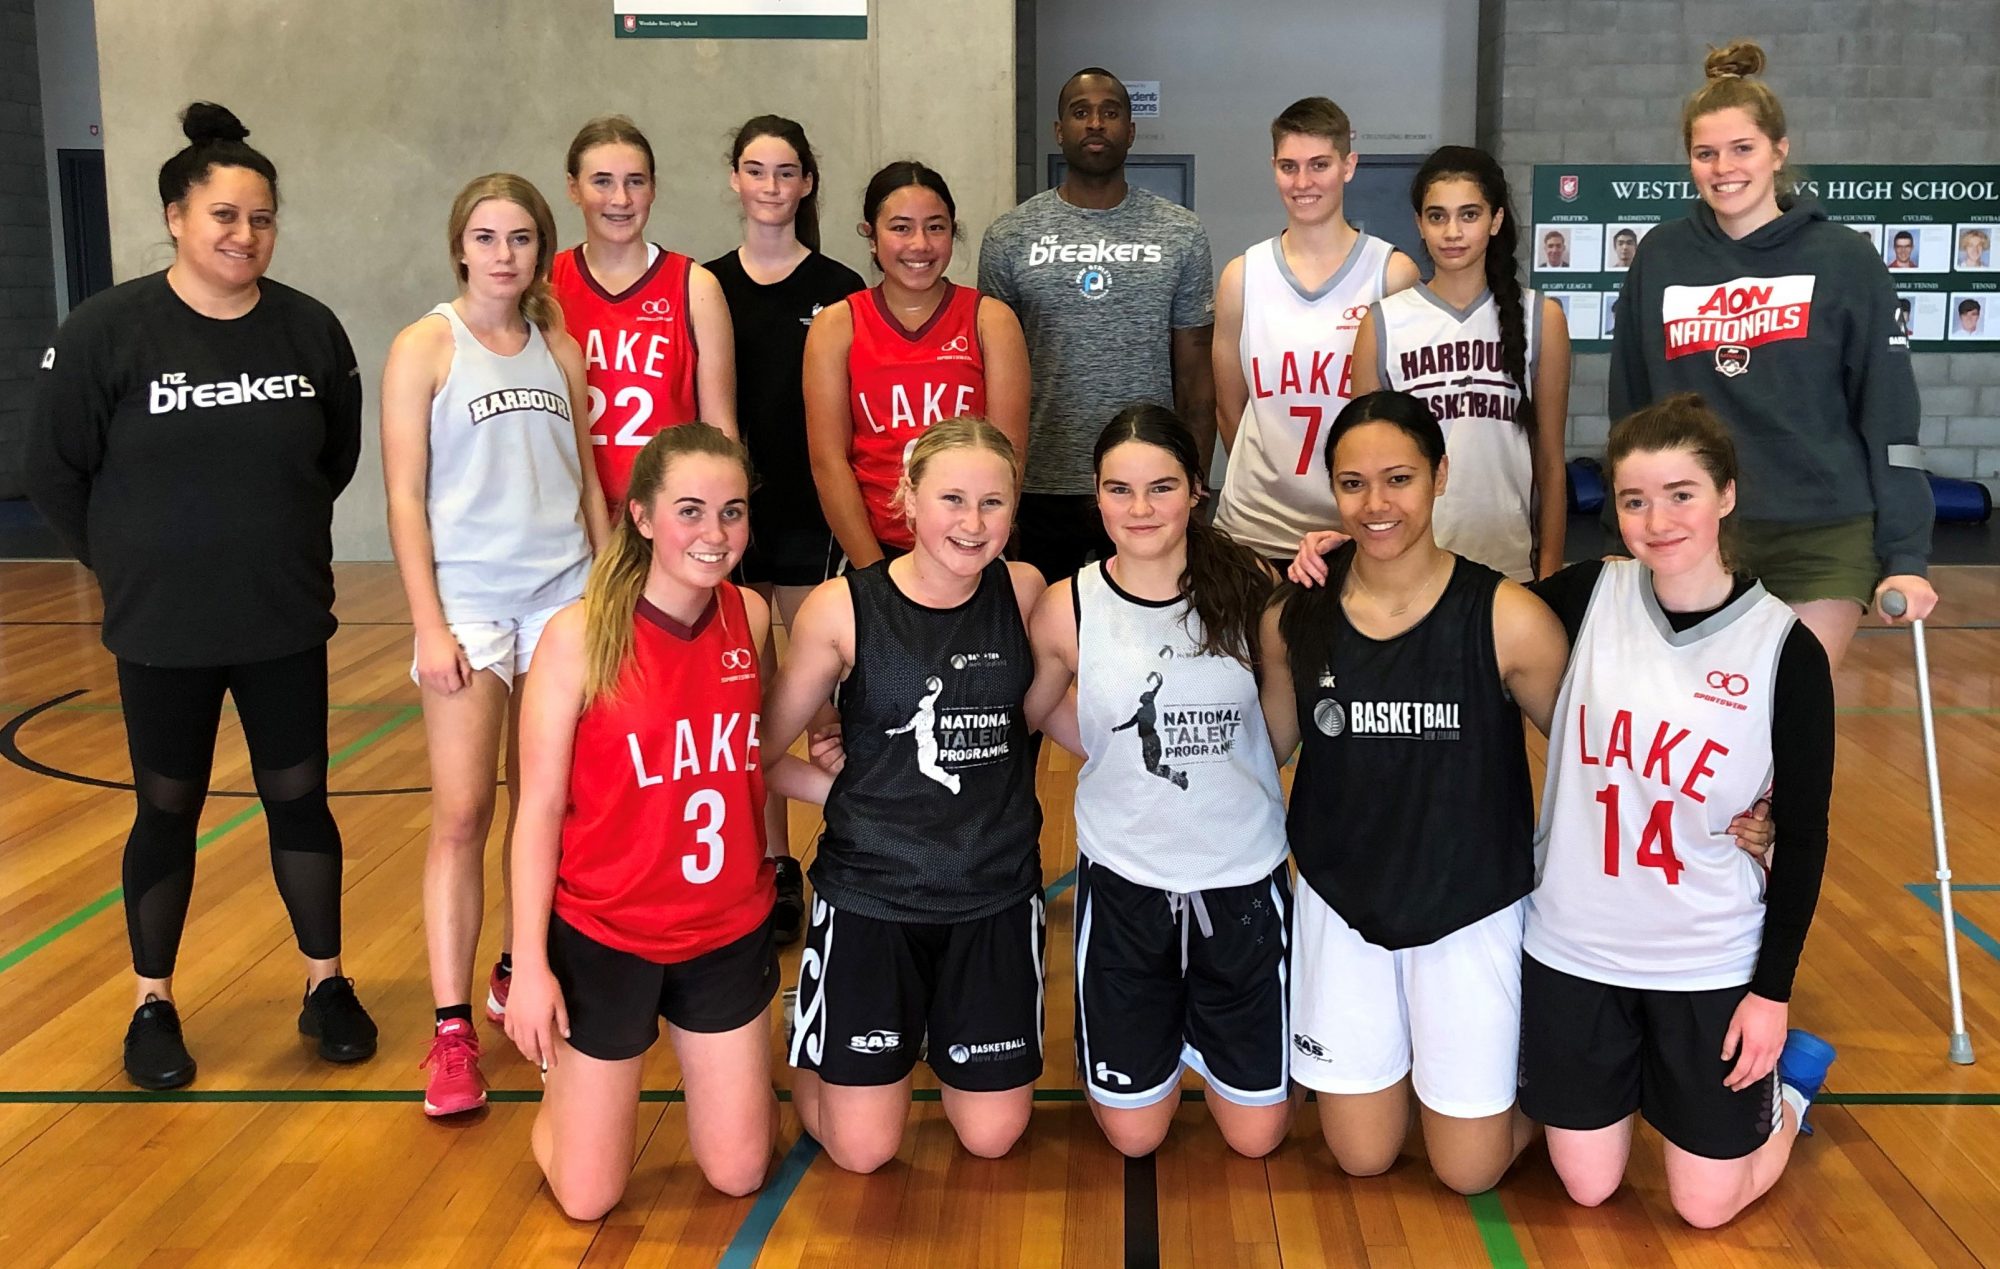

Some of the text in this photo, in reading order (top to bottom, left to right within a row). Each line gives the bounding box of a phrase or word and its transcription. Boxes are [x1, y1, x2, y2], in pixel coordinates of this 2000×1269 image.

[1611, 181, 1702, 200] WESTL
[1827, 181, 1893, 200] HIGH
[1901, 181, 1999, 200] SCHOOL
[1028, 239, 1162, 266] breakers
[1040, 234, 1059, 245] nz
[1698, 286, 1774, 316] AON
[1670, 306, 1802, 348] NATIONALS
[586, 329, 670, 379] AKE
[1400, 339, 1510, 381] HARBOU
[162, 372, 187, 384] nz
[149, 373, 316, 414] breakers
[468, 388, 570, 425] HARBOUR
[1289, 406, 1323, 475] 7
[1693, 692, 1748, 711] SPORTSWEAR
[939, 713, 1011, 730] NATIONAL
[1163, 709, 1241, 726] NATIONAL
[1351, 701, 1461, 734] BASKETBALL
[940, 726, 1011, 749] TALENT
[1164, 723, 1241, 746] TALENT
[626, 712, 761, 788] LAKE
[939, 742, 1010, 761] PROGRAMME
[1579, 704, 1730, 804] LAKE
[681, 788, 726, 885] 3
[1595, 783, 1686, 886] 14
[850, 1035, 900, 1048] SAS
[970, 1037, 1026, 1054] BASKETBALL
[1293, 1033, 1324, 1057] SAS
